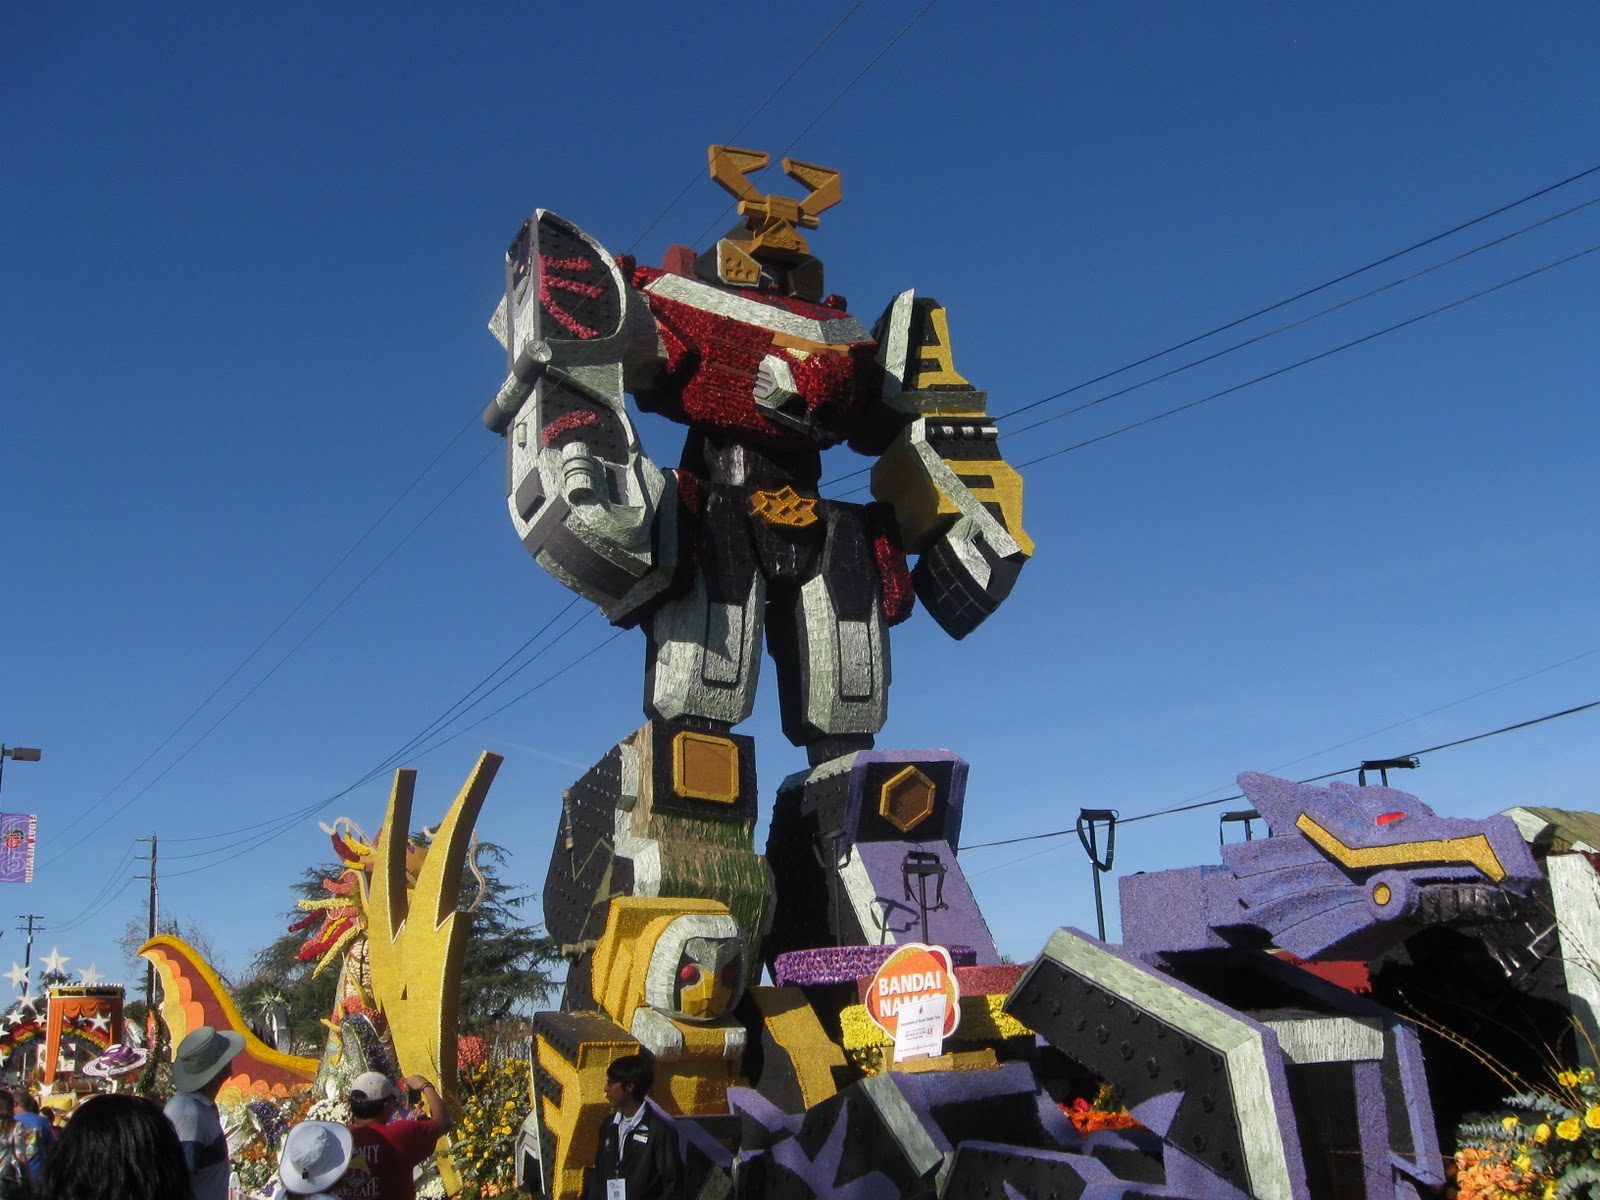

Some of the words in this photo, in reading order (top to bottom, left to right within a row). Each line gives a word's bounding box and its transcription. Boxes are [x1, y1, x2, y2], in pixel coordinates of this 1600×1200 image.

[28, 814, 38, 839] FLOAT
[25, 842, 36, 883] VIEWING
[878, 970, 942, 997] BANDAI
